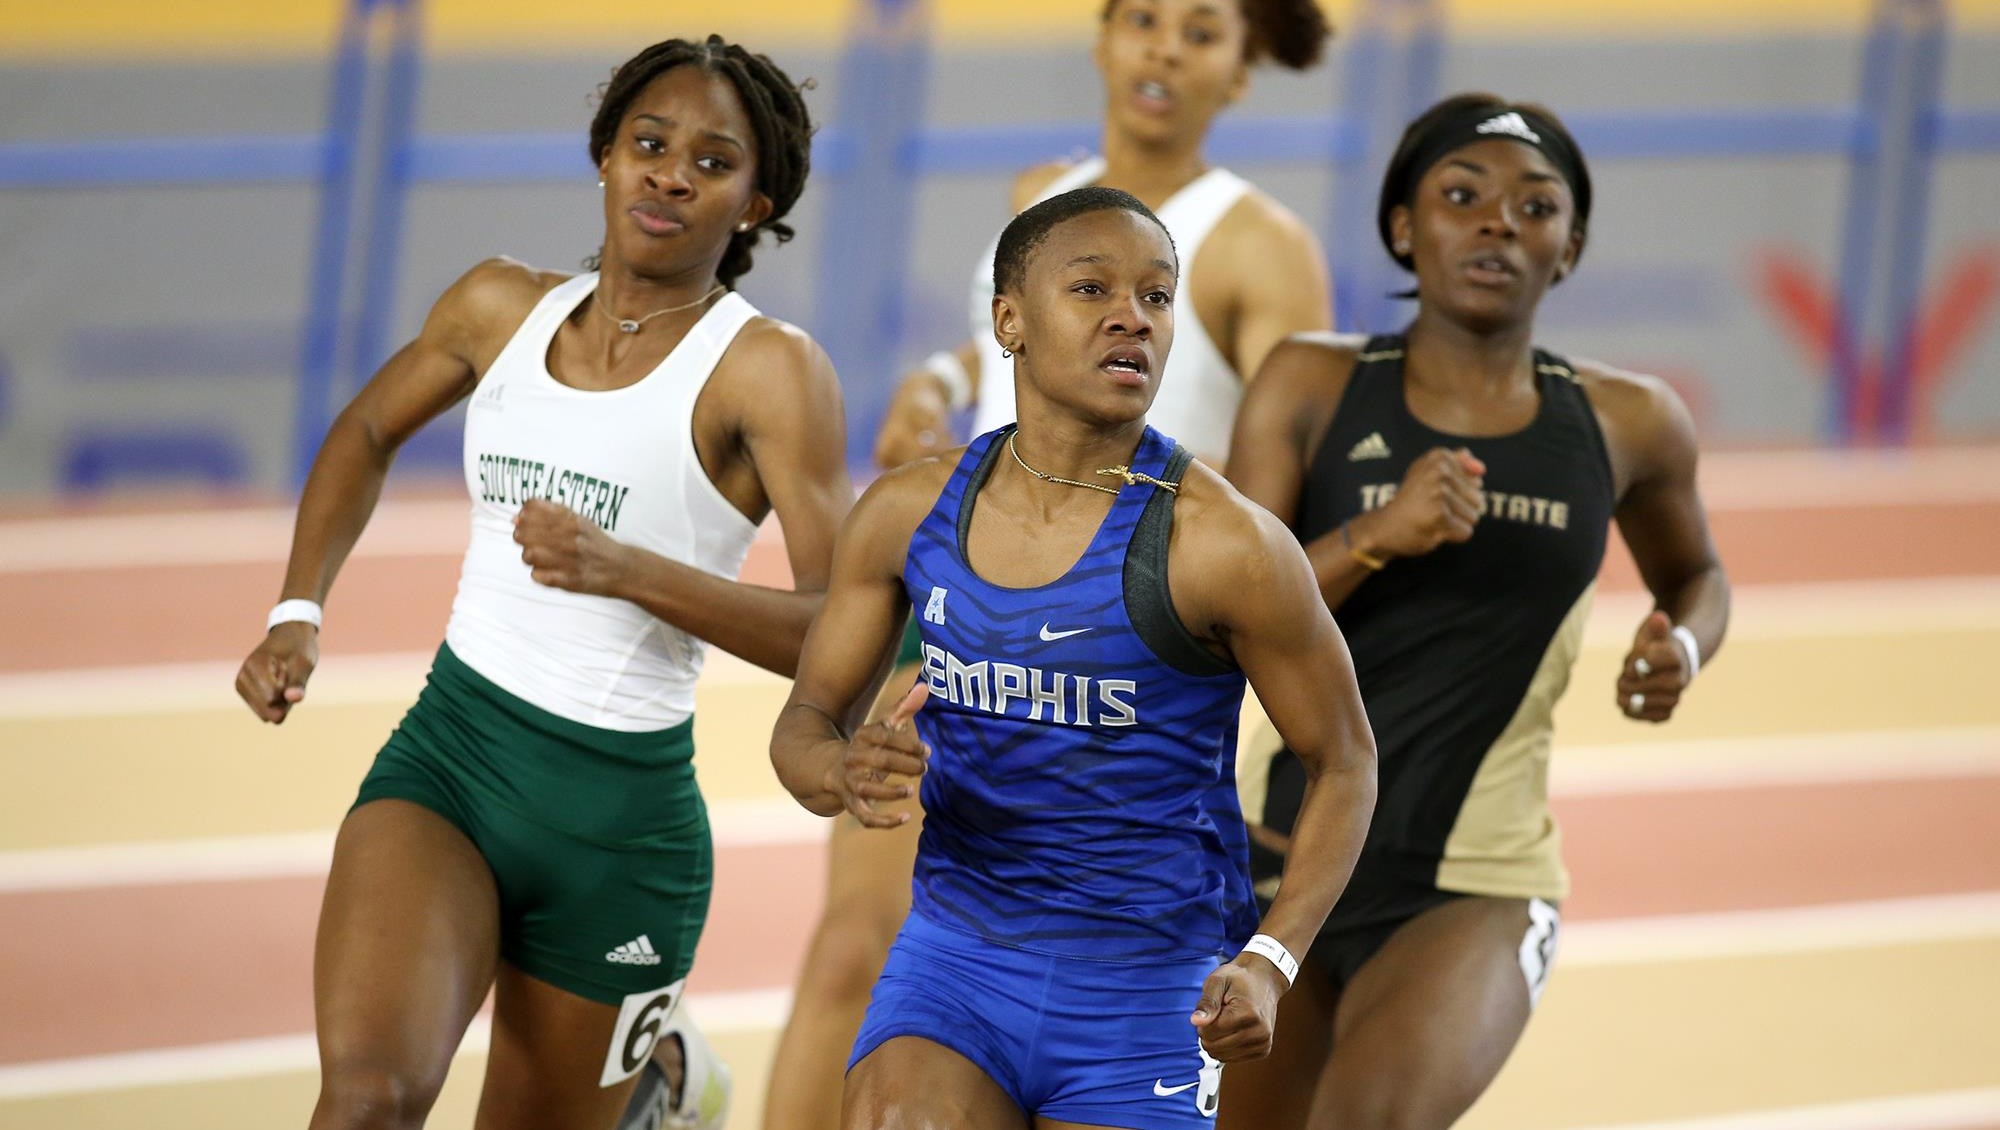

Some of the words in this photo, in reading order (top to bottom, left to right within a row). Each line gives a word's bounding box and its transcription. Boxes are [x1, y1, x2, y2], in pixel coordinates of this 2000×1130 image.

[479, 453, 629, 531] SOUTHEASTERN
[920, 640, 1138, 727] EMPHIS
[622, 993, 671, 1073] 6
